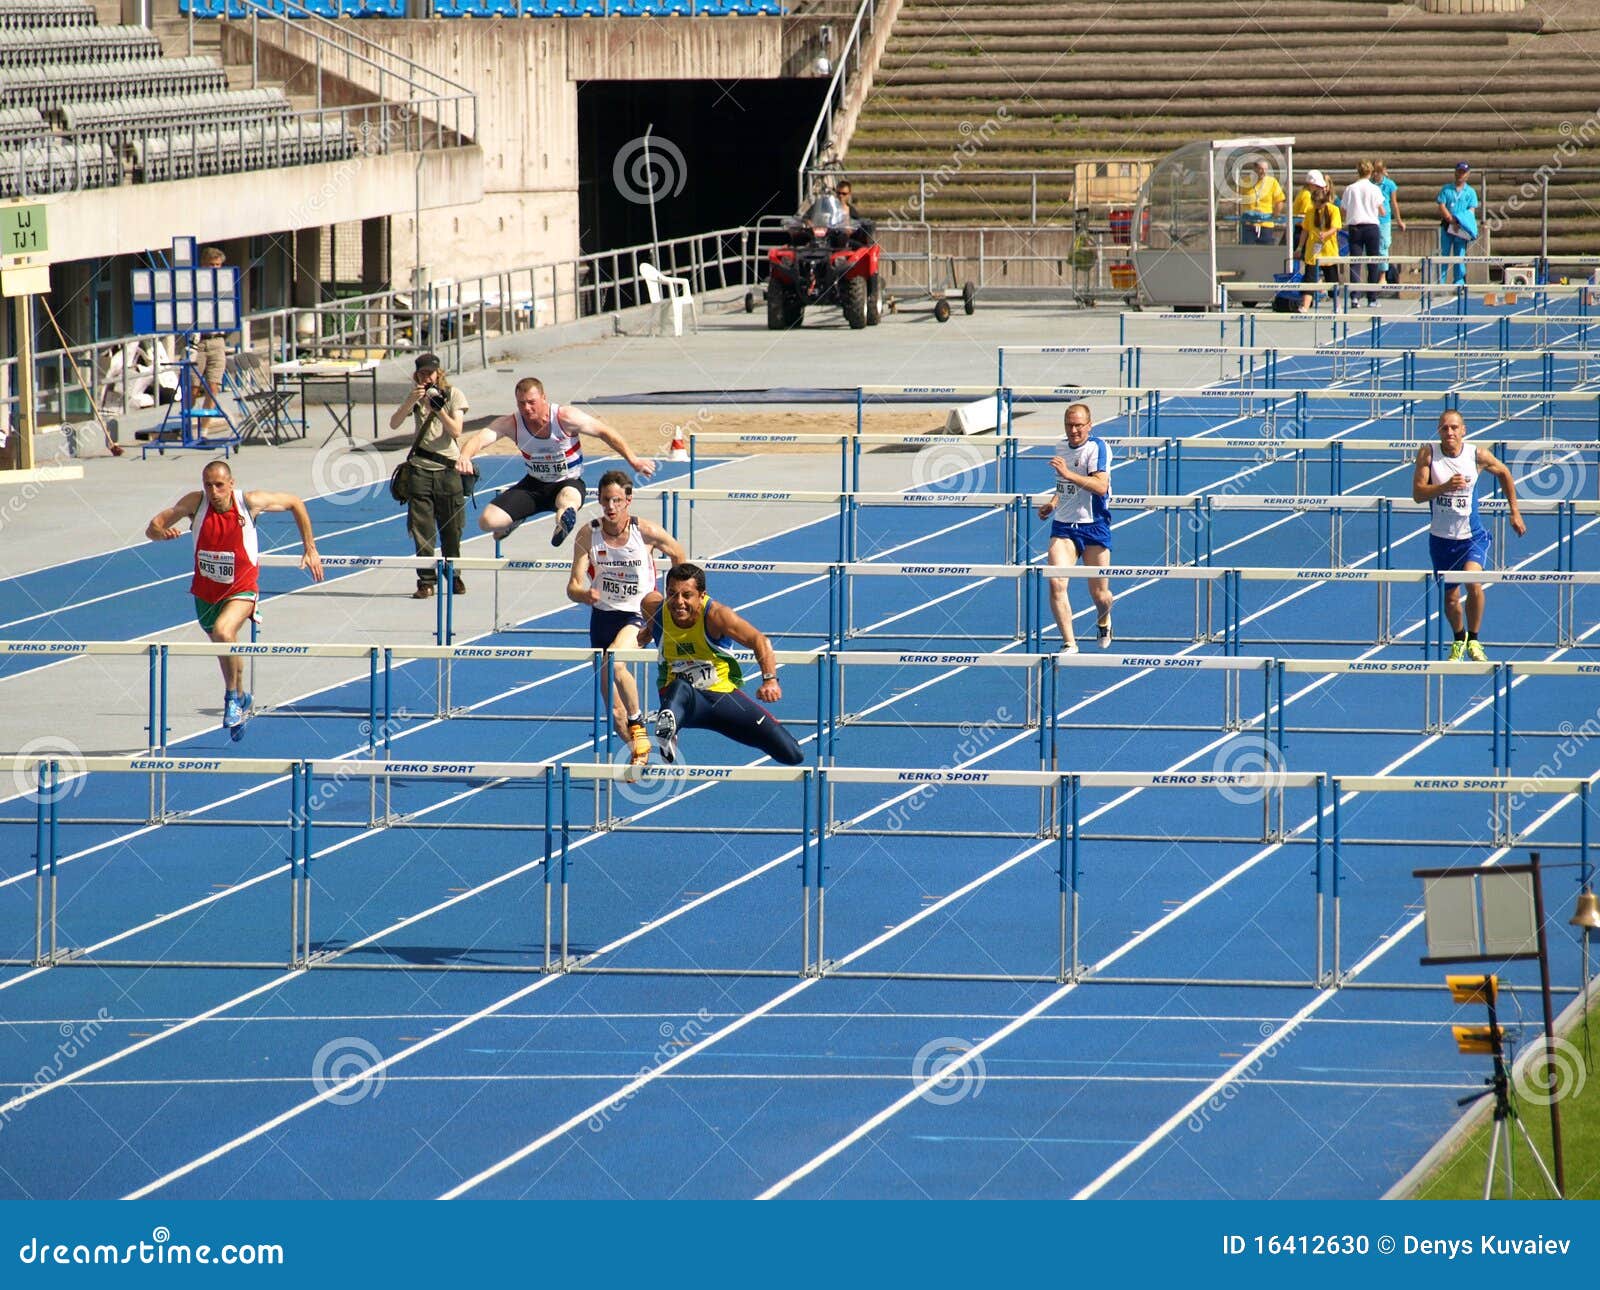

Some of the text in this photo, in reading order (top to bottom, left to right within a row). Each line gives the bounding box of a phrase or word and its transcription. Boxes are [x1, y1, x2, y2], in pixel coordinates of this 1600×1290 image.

[17, 210, 31, 228] LJ
[13, 230, 37, 248] TJ 1
[532, 462, 566, 473] M35 164
[1456, 498, 1466, 508] 33
[219, 566, 234, 577] 180
[705, 562, 776, 571] KERKO SPORT
[602, 580, 638, 596] M35 145
[7, 644, 88, 652] KERKO SPORT
[229, 646, 310, 654] KERKO SPORT
[453, 649, 533, 657] KERKO SPORT
[899, 655, 980, 663] KERKO SPORT
[1121, 658, 1203, 667] KERKO SPORT
[1348, 662, 1430, 671] KERKO SPORT
[1577, 665, 1600, 673] KER
[700, 667, 712, 680] 17
[129, 760, 222, 770] KERKO SPORT
[384, 764, 476, 774] KERKO SPORT
[641, 768, 733, 777] KERKO SPORT
[898, 772, 990, 782] KERKO SPORT
[1151, 775, 1245, 784] KERKO SPORT
[1413, 779, 1508, 789] KERKO SPORT
